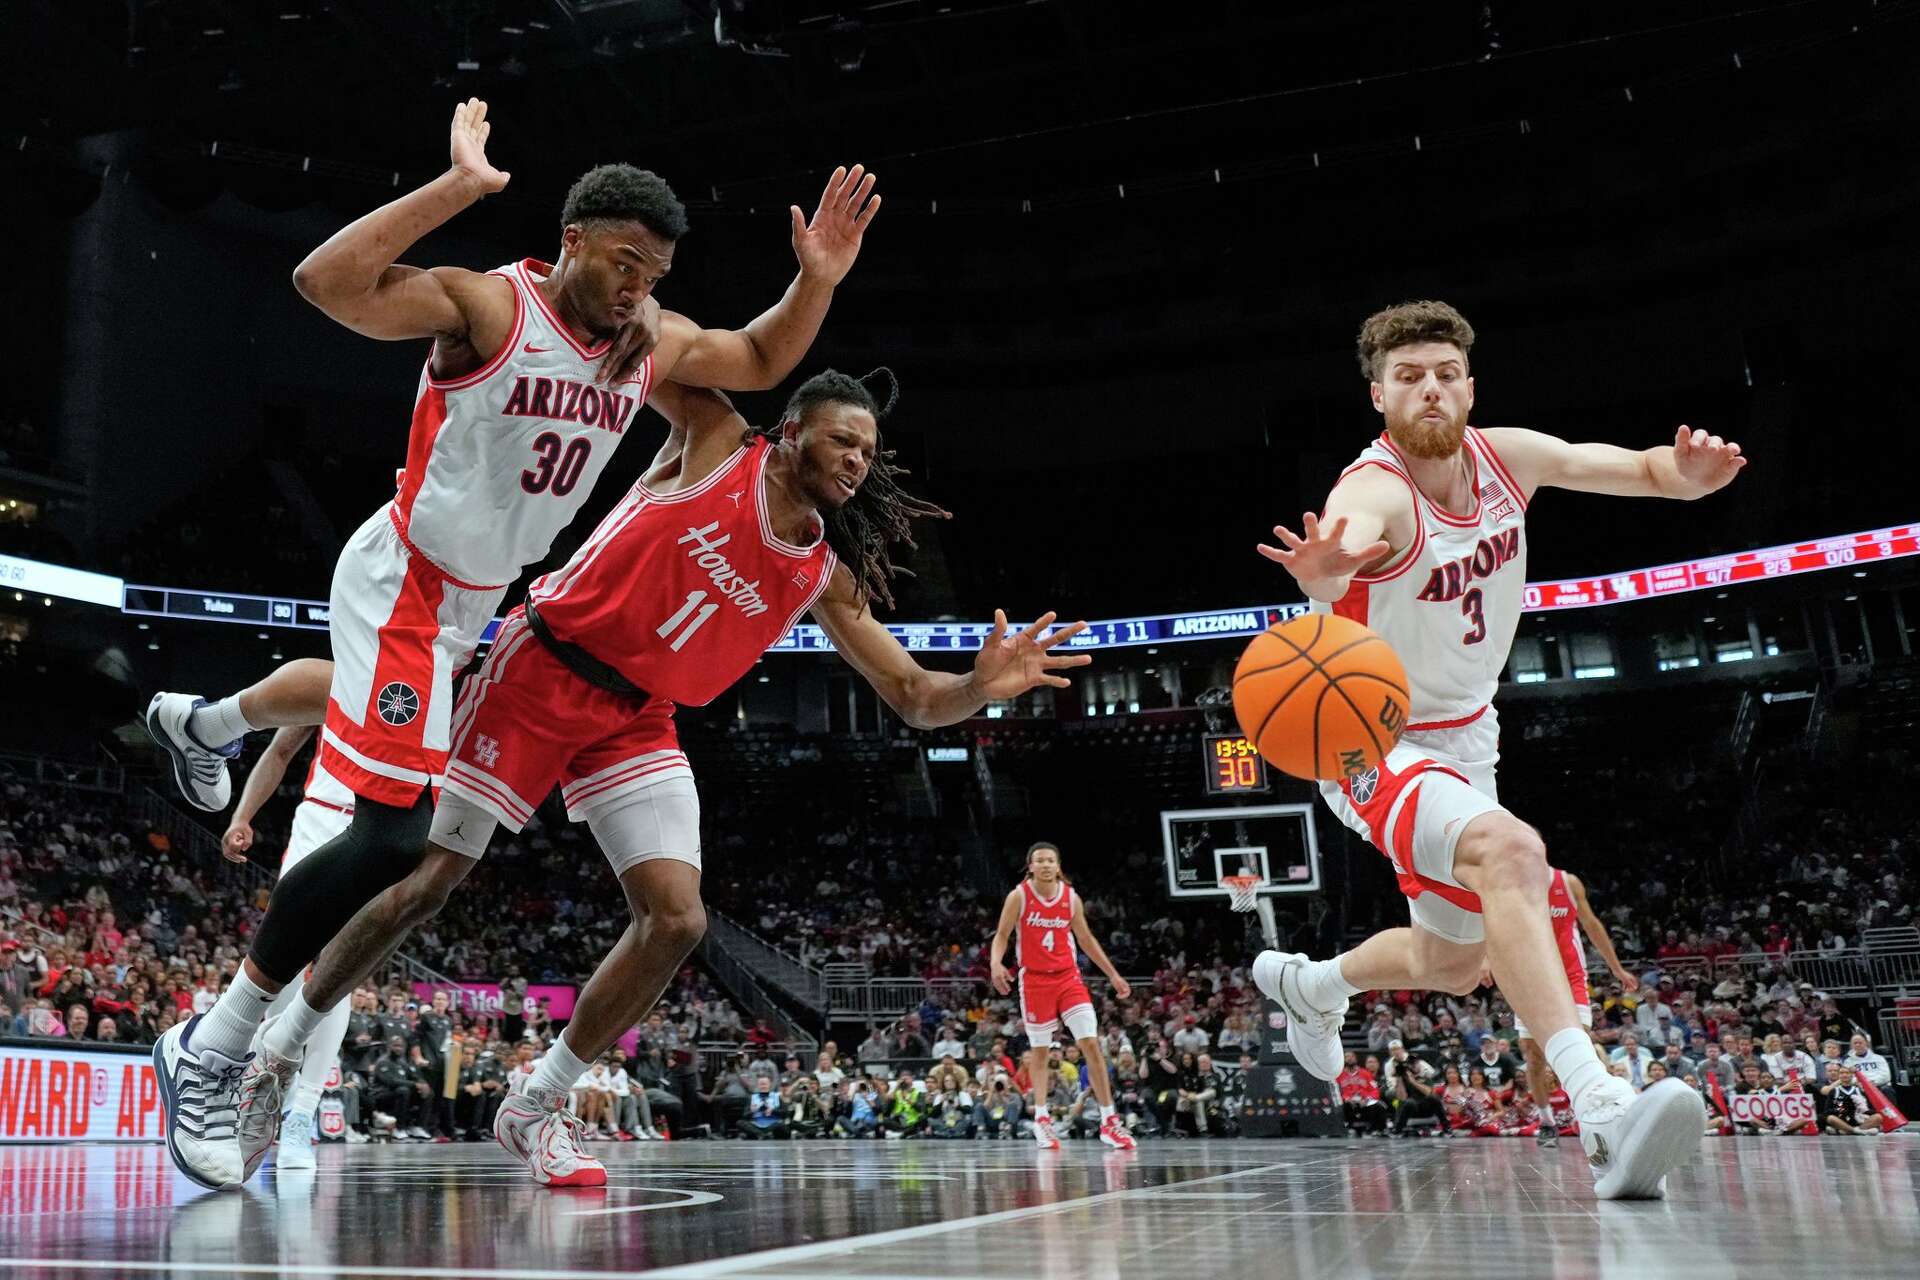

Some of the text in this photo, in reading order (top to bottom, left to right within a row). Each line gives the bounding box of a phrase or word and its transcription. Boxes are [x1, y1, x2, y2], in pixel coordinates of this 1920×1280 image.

[520, 431, 592, 497] 30
[677, 520, 769, 618] Houston
[1416, 526, 1519, 603] ARIONA
[655, 590, 720, 653] 11
[1126, 621, 1149, 642] 11
[1173, 612, 1258, 636] ARIZONA
[1461, 587, 1487, 646] 3
[907, 635, 931, 649] 2/2
[1216, 739, 1258, 757] 13:54
[1218, 757, 1256, 787] 30
[1026, 911, 1070, 929] Houston
[1041, 930, 1055, 953] 4
[1733, 1096, 1813, 1120] COOGS
